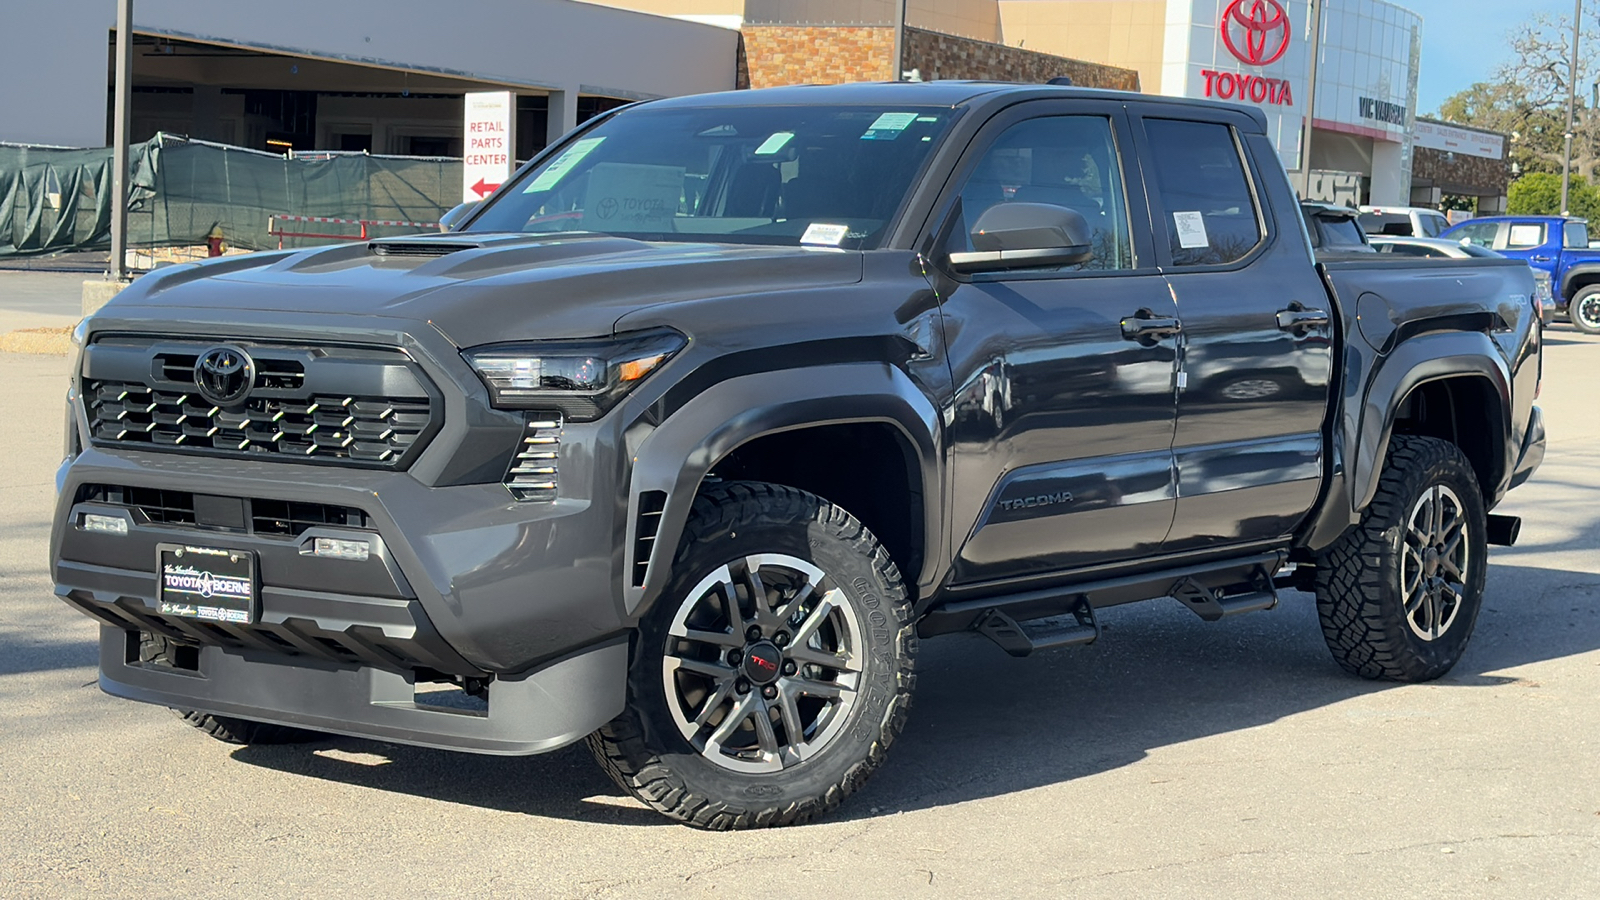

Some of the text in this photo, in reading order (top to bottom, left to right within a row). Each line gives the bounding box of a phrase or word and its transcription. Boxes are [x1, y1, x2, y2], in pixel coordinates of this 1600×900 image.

[1201, 69, 1293, 106] TOYOTA
[1359, 96, 1374, 119] VIC
[470, 121, 504, 133] RETAIL
[471, 138, 502, 149] PARTS
[466, 154, 507, 165] CENTER
[623, 198, 664, 211] TOYOTA
[1000, 491, 1074, 511] TACOMA
[165, 575, 250, 594] TOYOTA BOERNE
[751, 655, 776, 671] TRD
[851, 576, 894, 743] GOODYEAR
